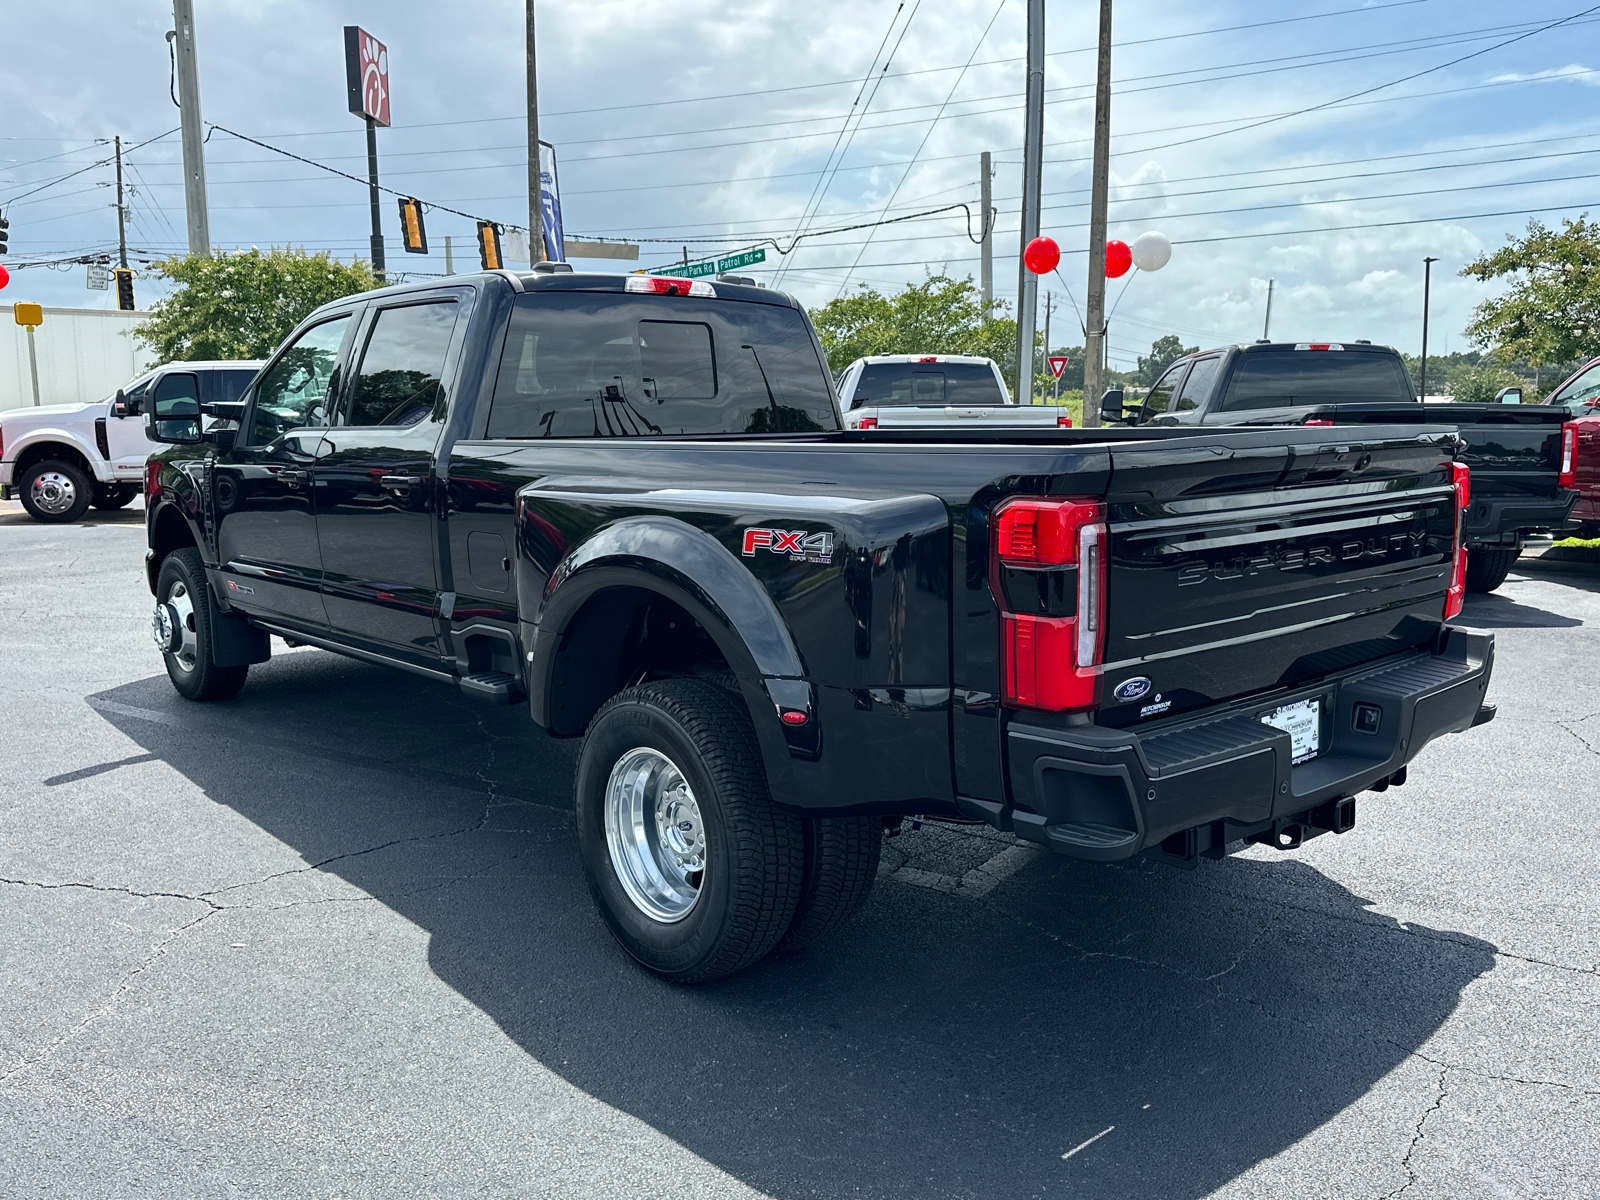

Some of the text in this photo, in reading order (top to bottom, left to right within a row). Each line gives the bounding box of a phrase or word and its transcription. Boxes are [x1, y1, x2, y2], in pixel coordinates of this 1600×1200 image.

[688, 266, 702, 276] Park
[703, 263, 712, 273] Rd
[720, 254, 754, 270] Patrol Rd
[742, 527, 833, 558] FX4
[1178, 530, 1426, 587] SUPER DUTY
